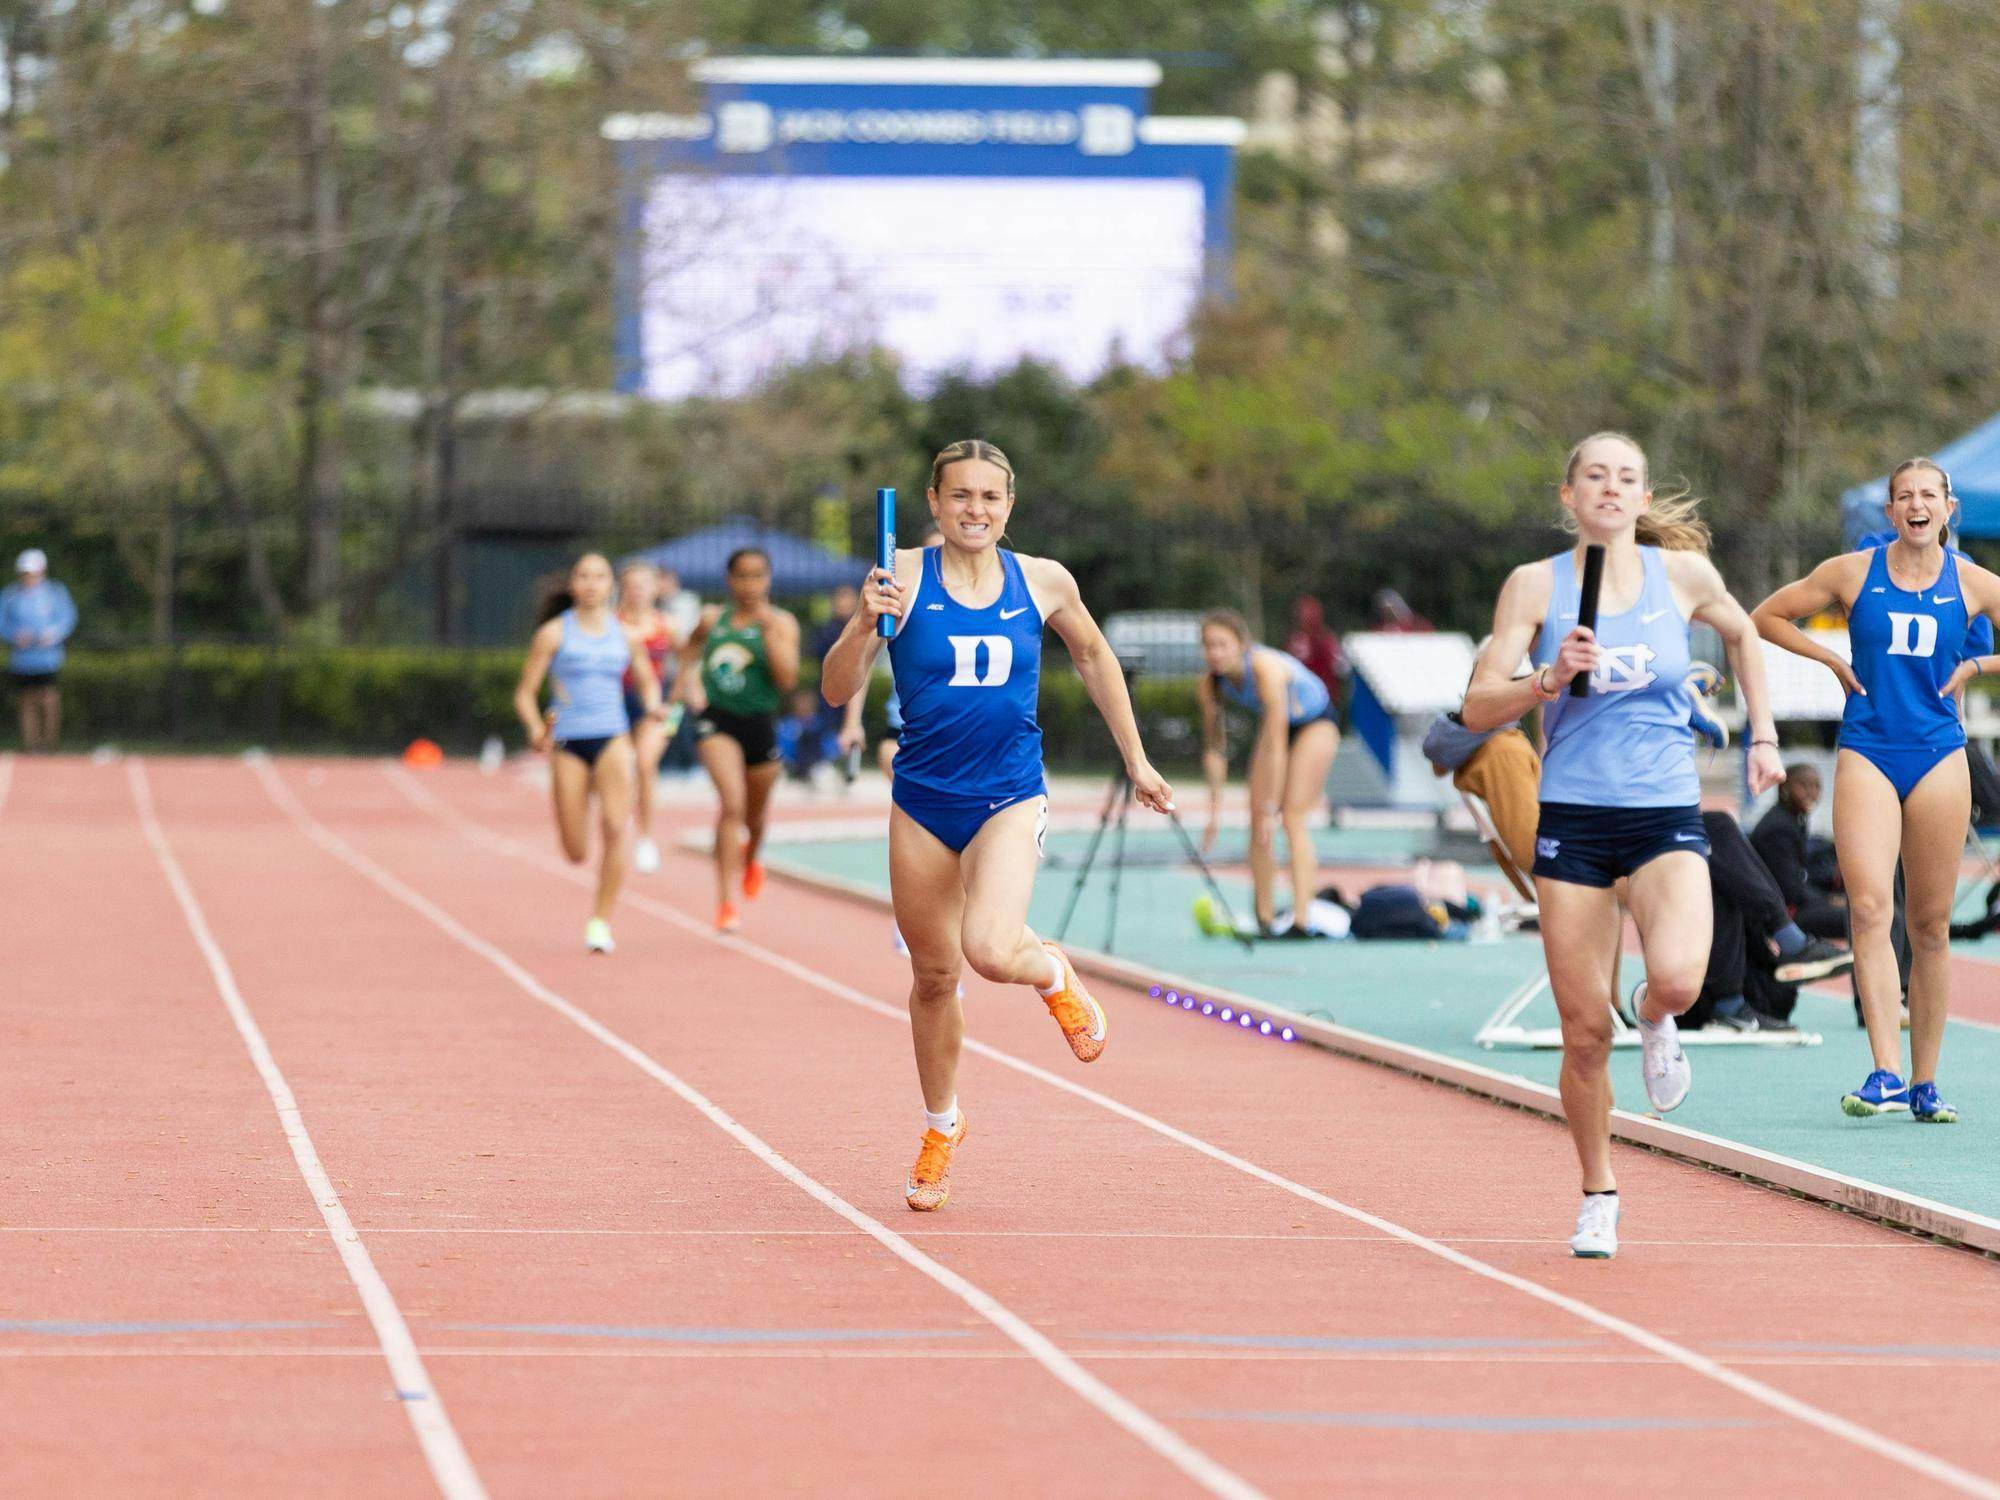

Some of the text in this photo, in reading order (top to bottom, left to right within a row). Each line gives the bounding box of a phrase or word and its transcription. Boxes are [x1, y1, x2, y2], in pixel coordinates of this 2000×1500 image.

[848, 109, 985, 145] COOMBS
[988, 110, 1075, 145] FIELD
[1886, 611, 1938, 657] D
[947, 635, 1013, 687] D
